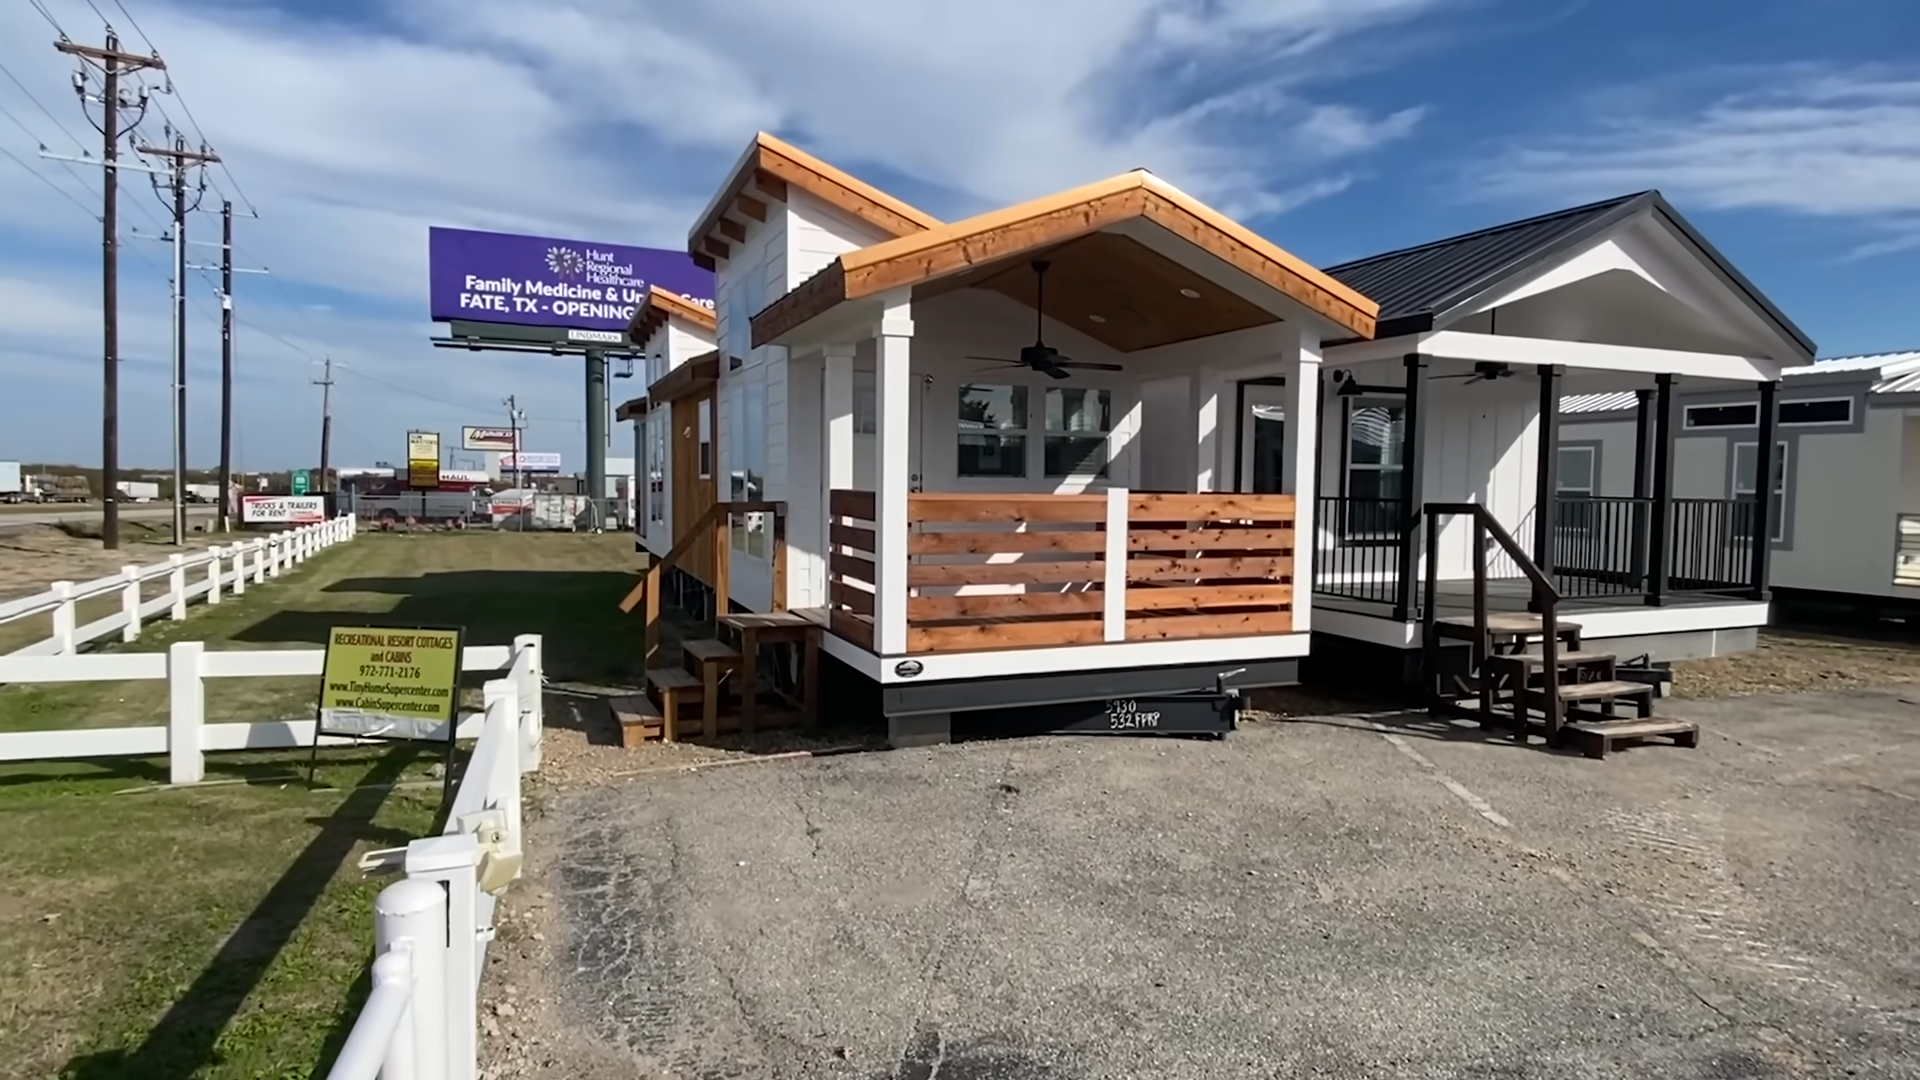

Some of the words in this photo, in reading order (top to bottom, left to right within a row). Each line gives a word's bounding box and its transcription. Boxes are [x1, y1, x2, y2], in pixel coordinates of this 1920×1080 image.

[586, 249, 613, 262] Hunt
[586, 261, 632, 276] Regional
[586, 272, 644, 287] Healthcare
[465, 275, 521, 296] Family
[525, 280, 602, 300] Medicine
[606, 287, 618, 302] &
[460, 293, 509, 313] FATE,
[513, 297, 538, 313] TX
[552, 301, 635, 320] OPENING
[571, 331, 618, 341] LINDMARK
[251, 502, 276, 510] TRUCKS
[287, 502, 317, 510] TRAILERS
[334, 633, 385, 647] RECREATIONAL
[387, 635, 415, 648] RESORT
[416, 636, 453, 650] COTTAGES
[370, 651, 383, 662] and
[385, 651, 412, 663] CABINS
[359, 665, 421, 679] 972-771-2176
[329, 681, 449, 698] www.TinyHomeSupercenter.com
[335, 697, 440, 713] www.CabinSupercenter.com
